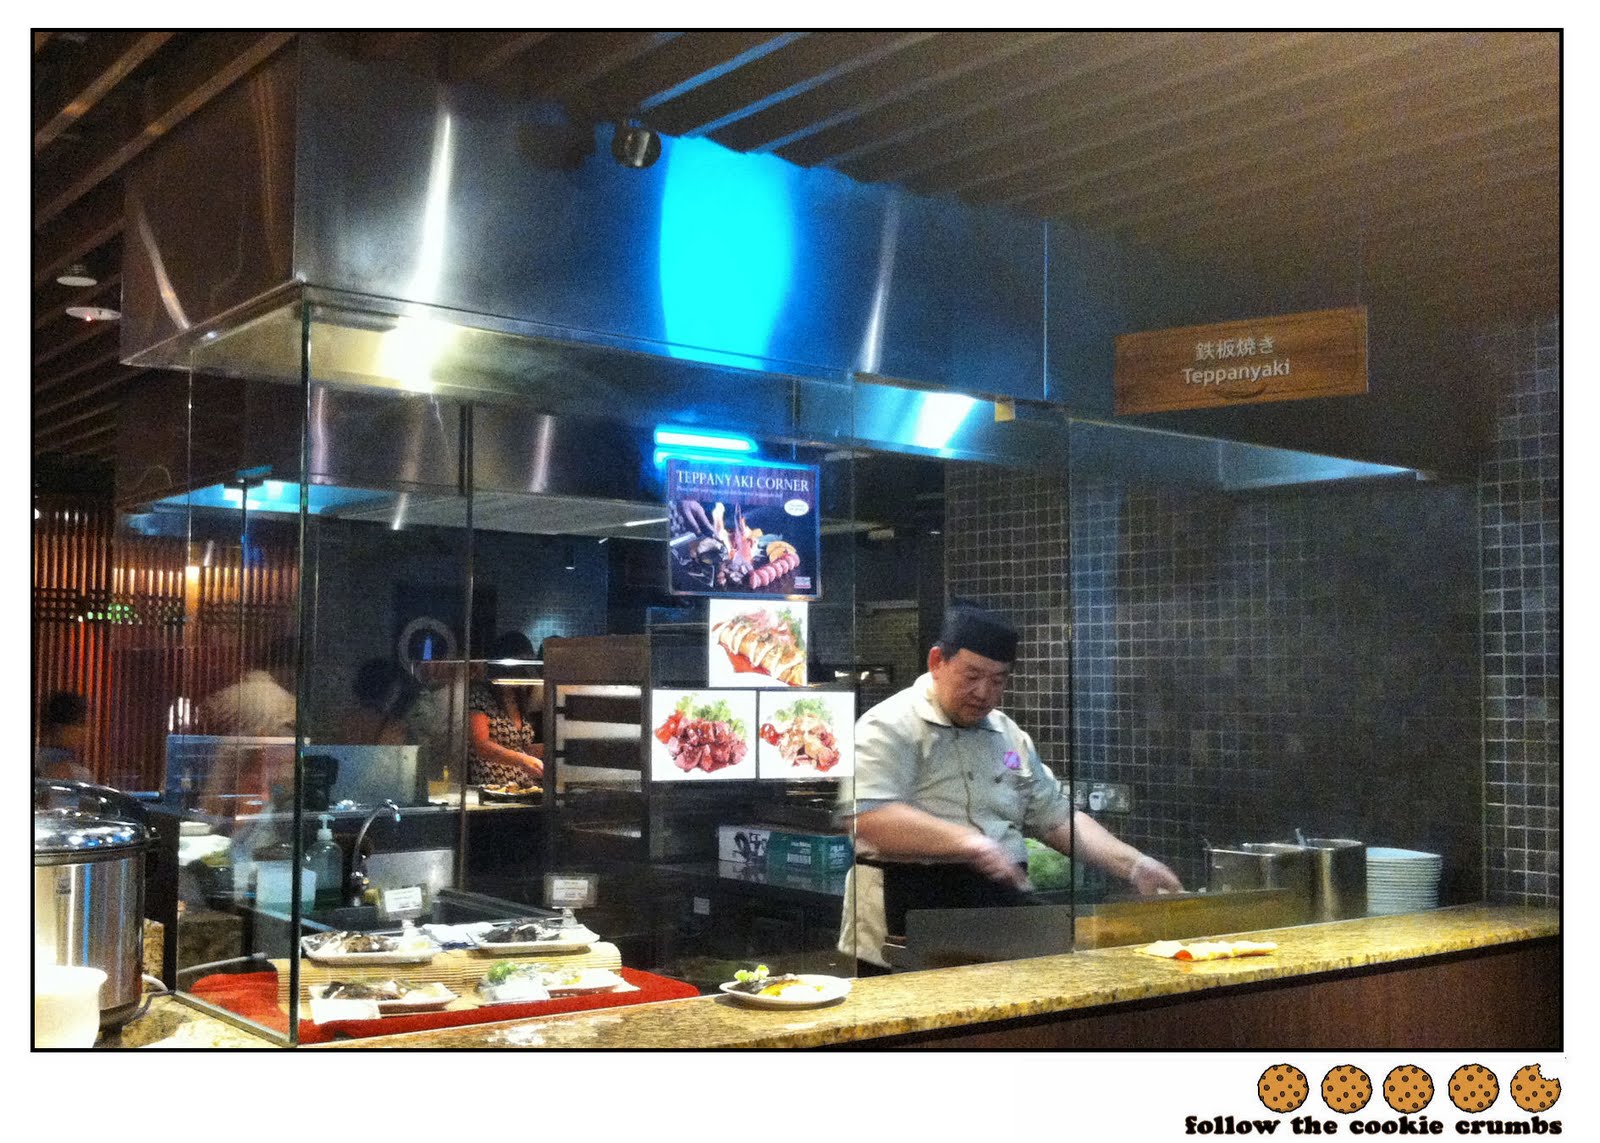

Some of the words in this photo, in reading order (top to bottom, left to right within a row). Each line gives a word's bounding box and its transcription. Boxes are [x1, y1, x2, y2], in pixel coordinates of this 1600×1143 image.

[1196, 336, 1274, 360] 鉄板焼き
[1182, 358, 1291, 386] Teppanyaki
[676, 470, 754, 489] TEPPANYAKI
[756, 477, 810, 492] CORNER
